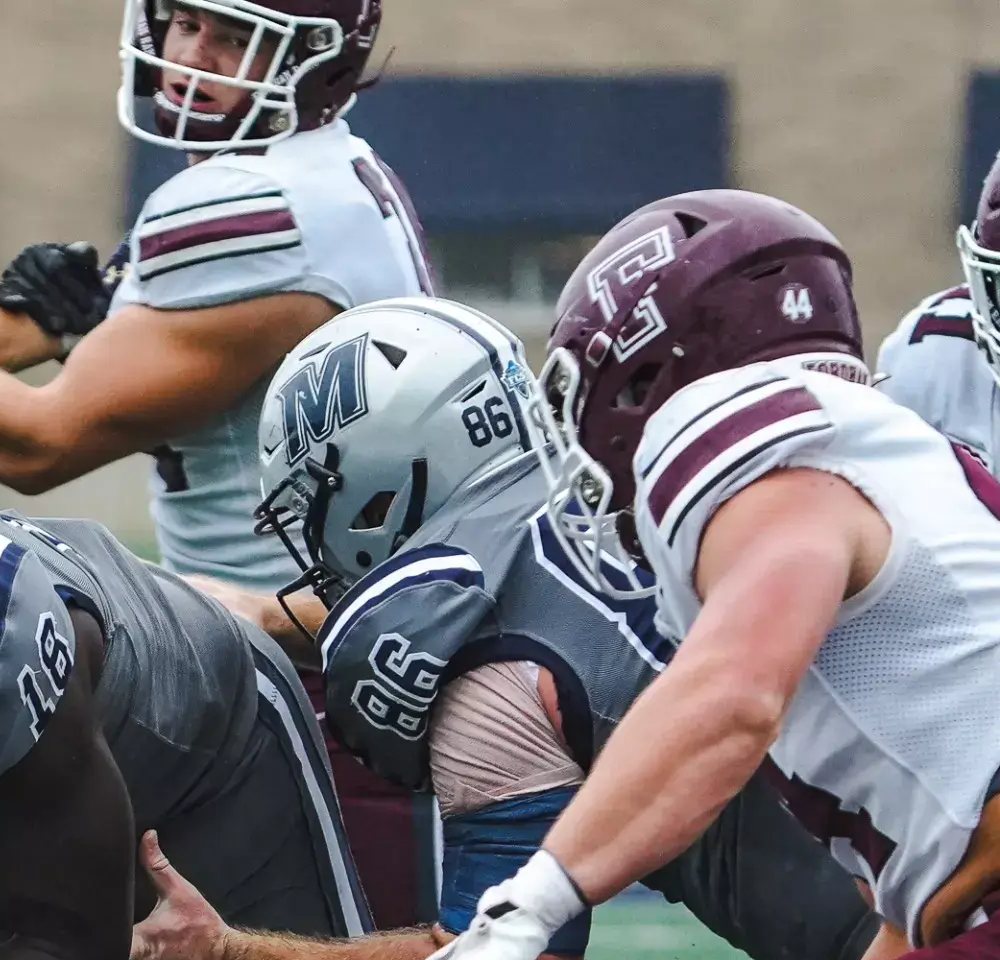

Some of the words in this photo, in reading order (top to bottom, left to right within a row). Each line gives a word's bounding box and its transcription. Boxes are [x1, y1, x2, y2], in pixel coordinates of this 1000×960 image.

[587, 225, 676, 363] F
[782, 287, 813, 321] 44
[278, 332, 369, 465] M
[462, 396, 513, 448] 86
[16, 611, 75, 742] 18
[352, 632, 449, 740] 86
